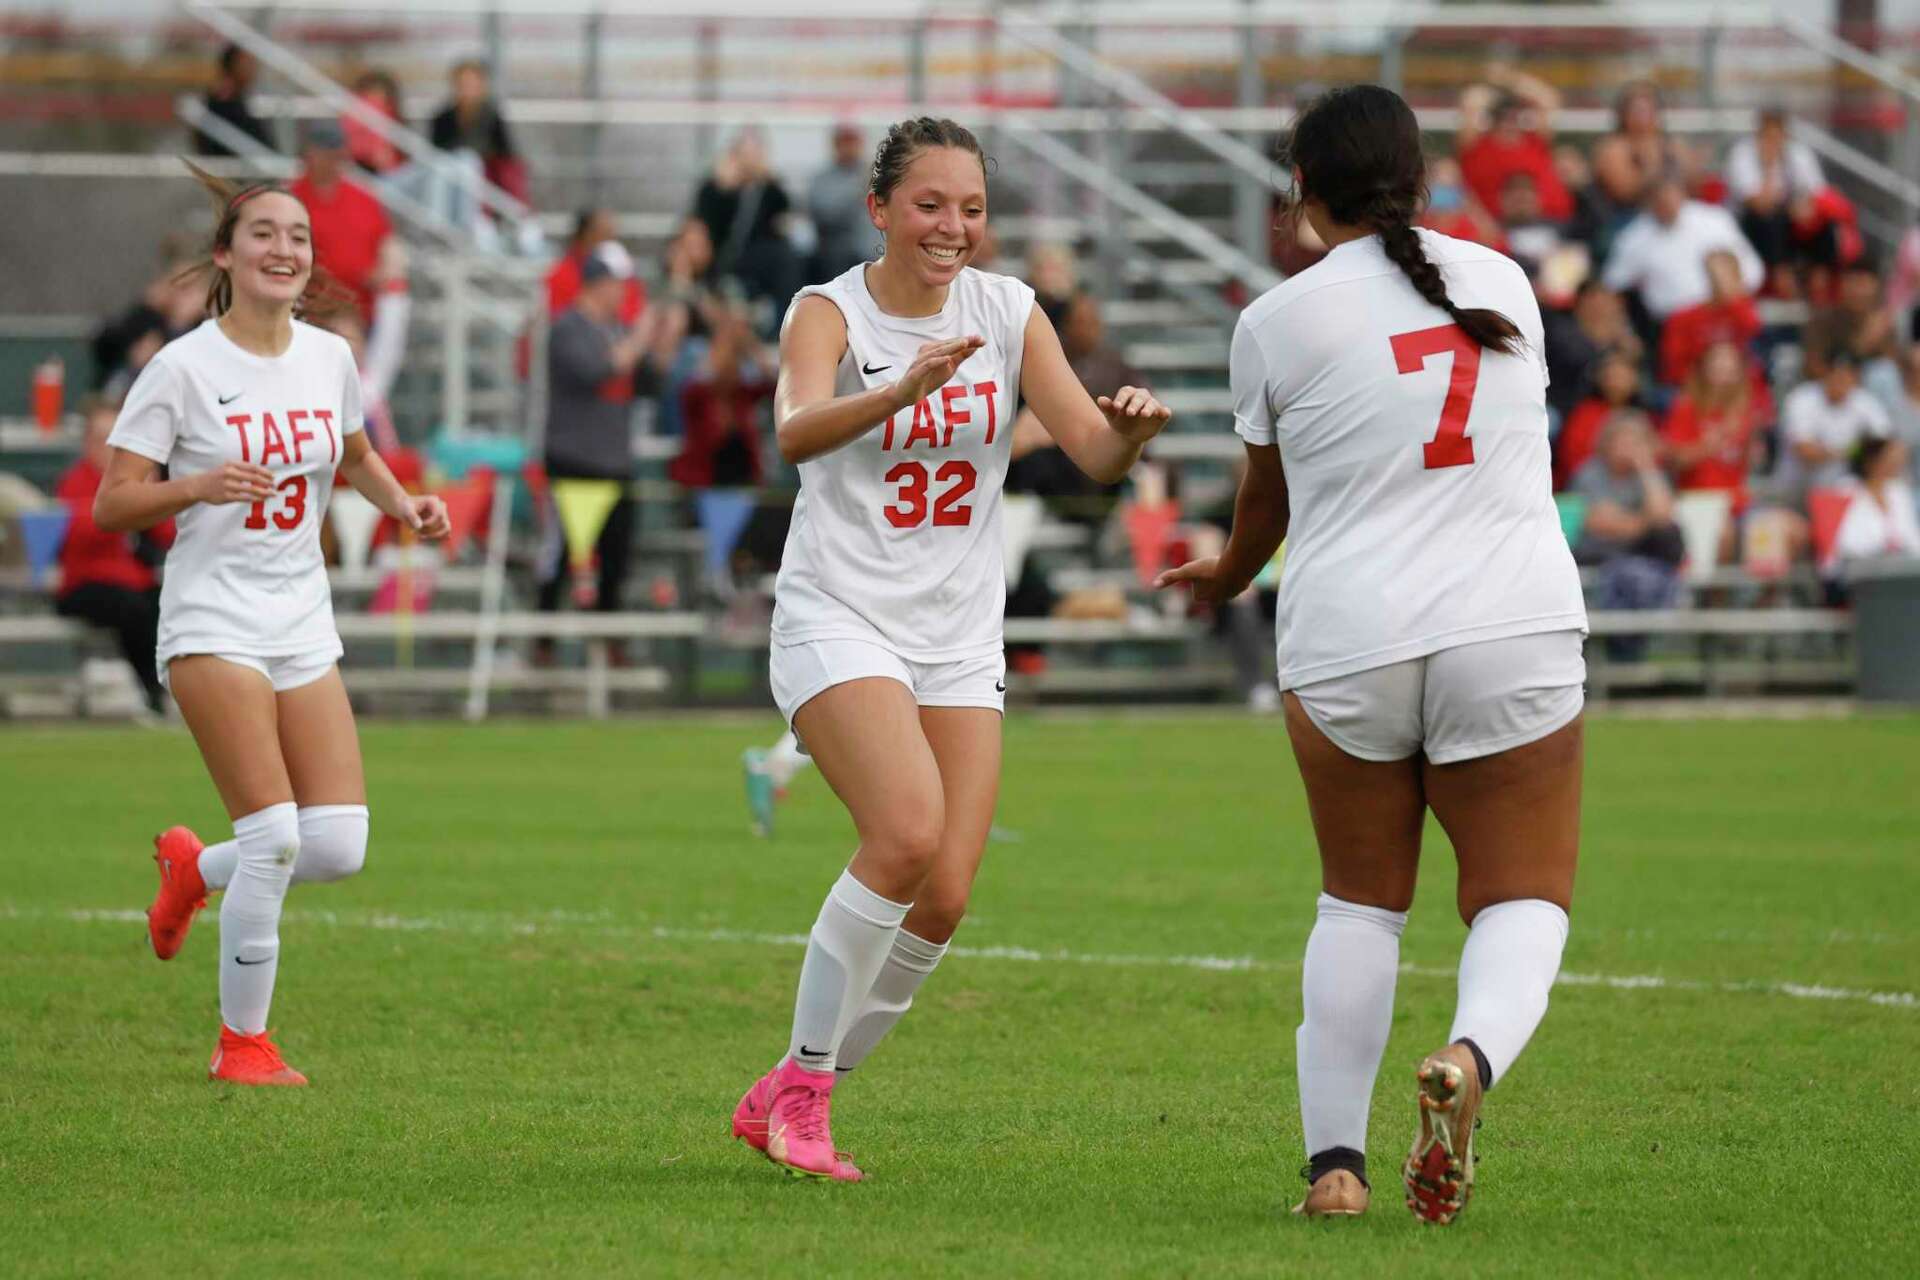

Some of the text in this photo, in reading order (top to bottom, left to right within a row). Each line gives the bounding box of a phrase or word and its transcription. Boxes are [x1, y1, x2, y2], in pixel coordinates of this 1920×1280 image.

[1389, 323, 1482, 469] 7
[226, 410, 336, 465] TAFT
[245, 475, 307, 530] 13
[883, 460, 977, 528] 32
